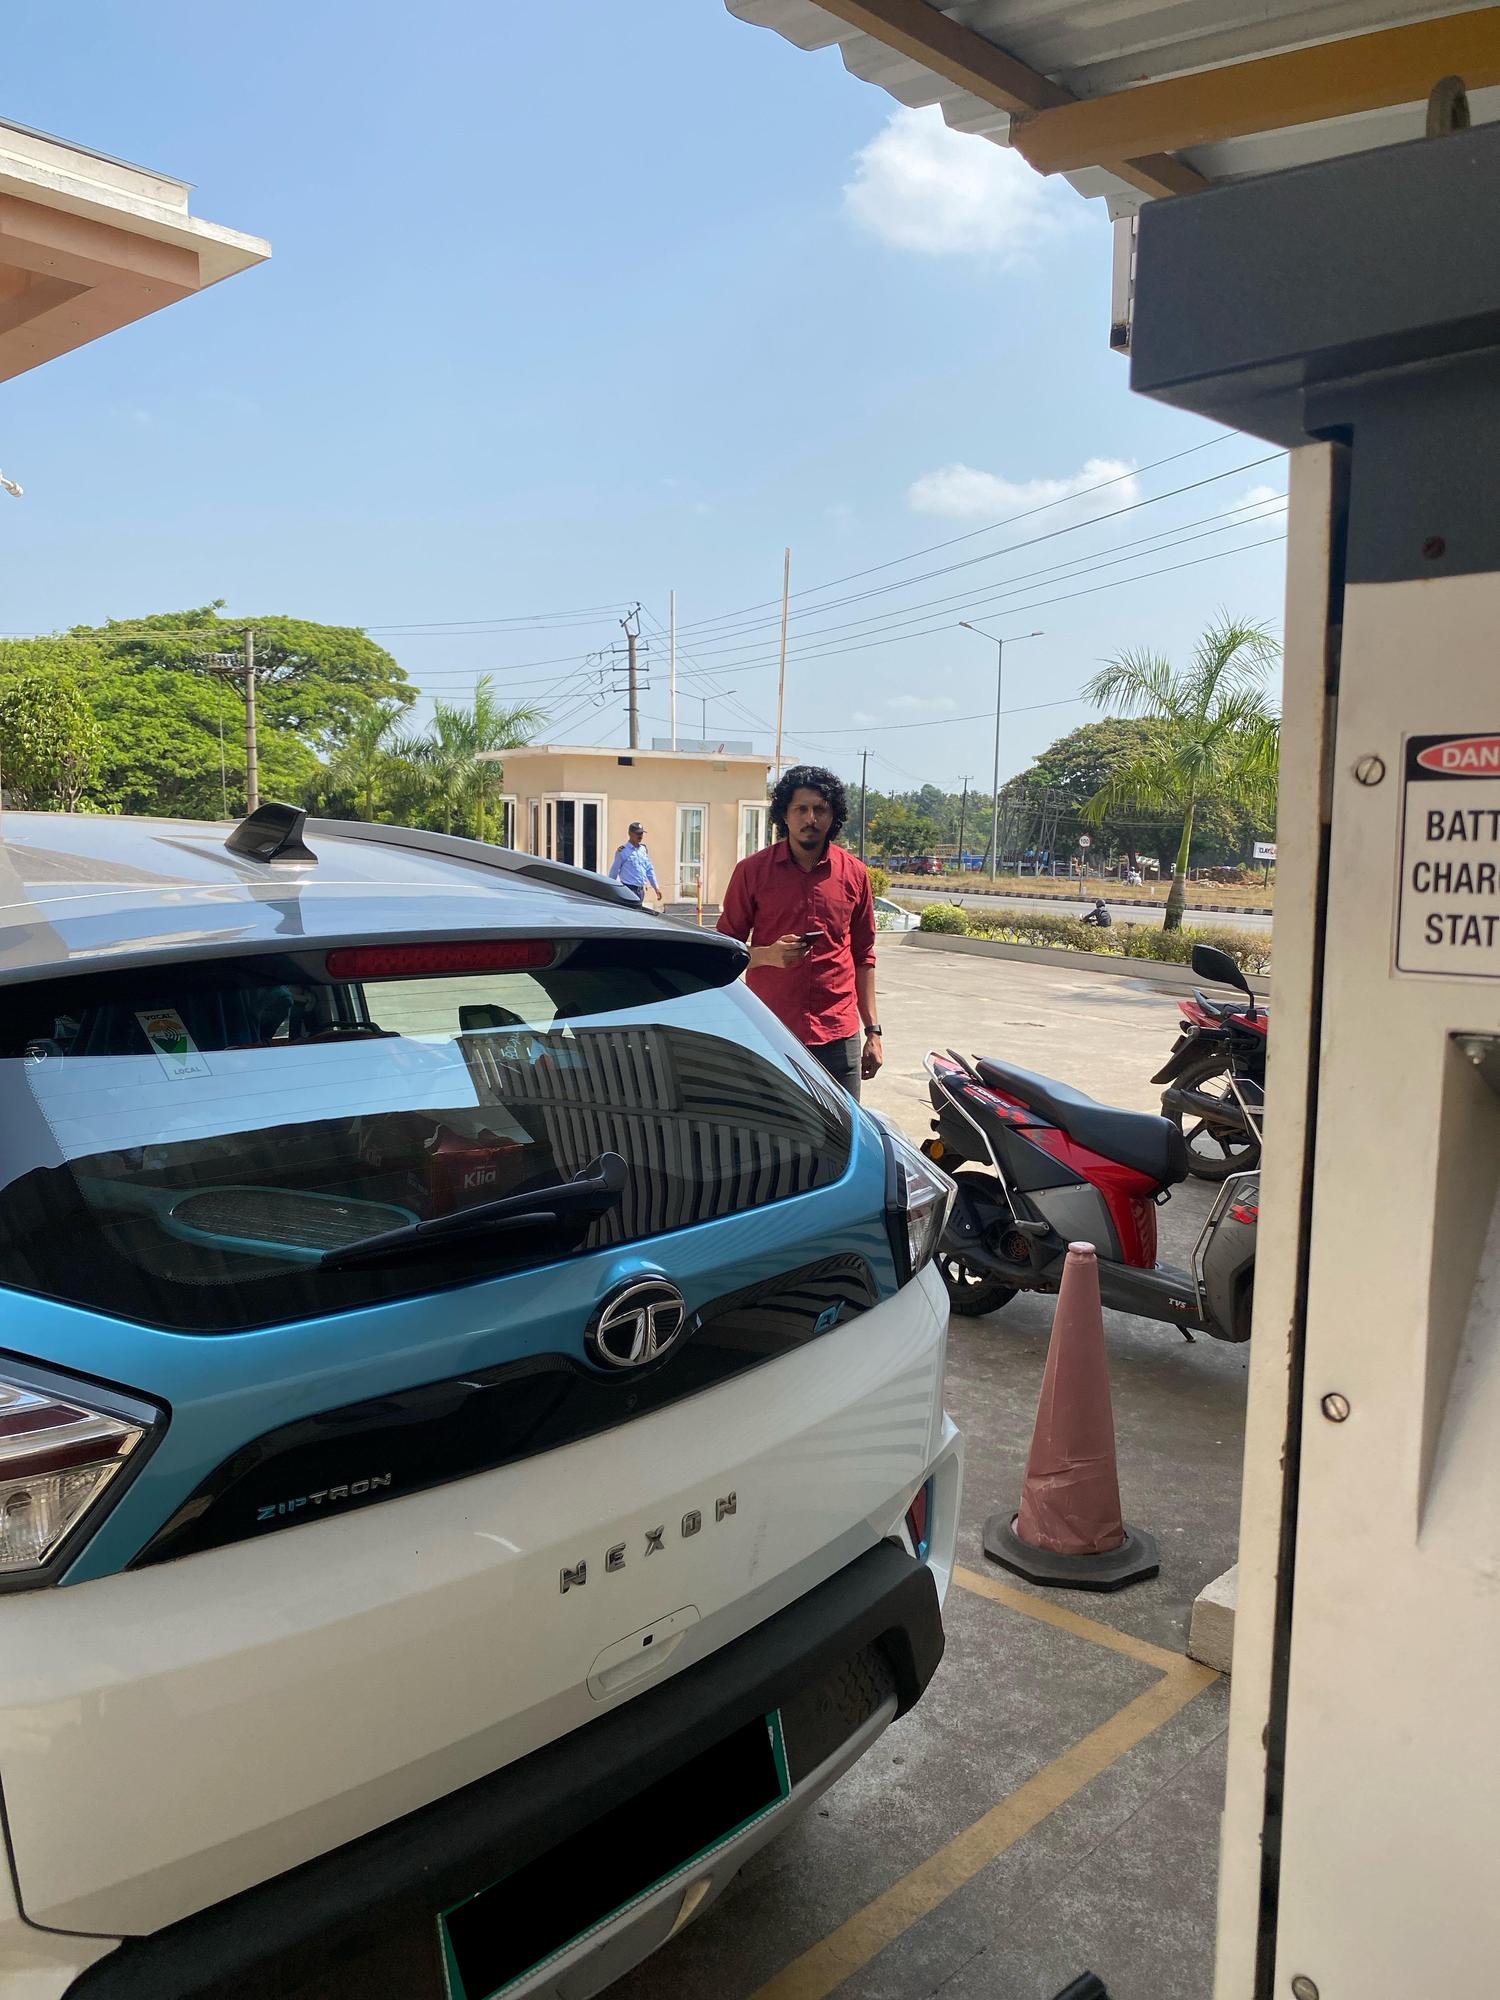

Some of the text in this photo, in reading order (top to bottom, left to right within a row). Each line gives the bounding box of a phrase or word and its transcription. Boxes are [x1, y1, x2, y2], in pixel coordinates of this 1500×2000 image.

[1442, 746, 1499, 768] DAN
[1426, 810, 1500, 841] BATT
[1412, 862, 1500, 893] CHAR
[1425, 913, 1500, 946] STAT
[174, 1066, 202, 1075] LOCAL
[1169, 1297, 1187, 1308] TVS
[257, 1472, 392, 1521] ZIPTRON
[559, 1490, 737, 1594] NEXON
